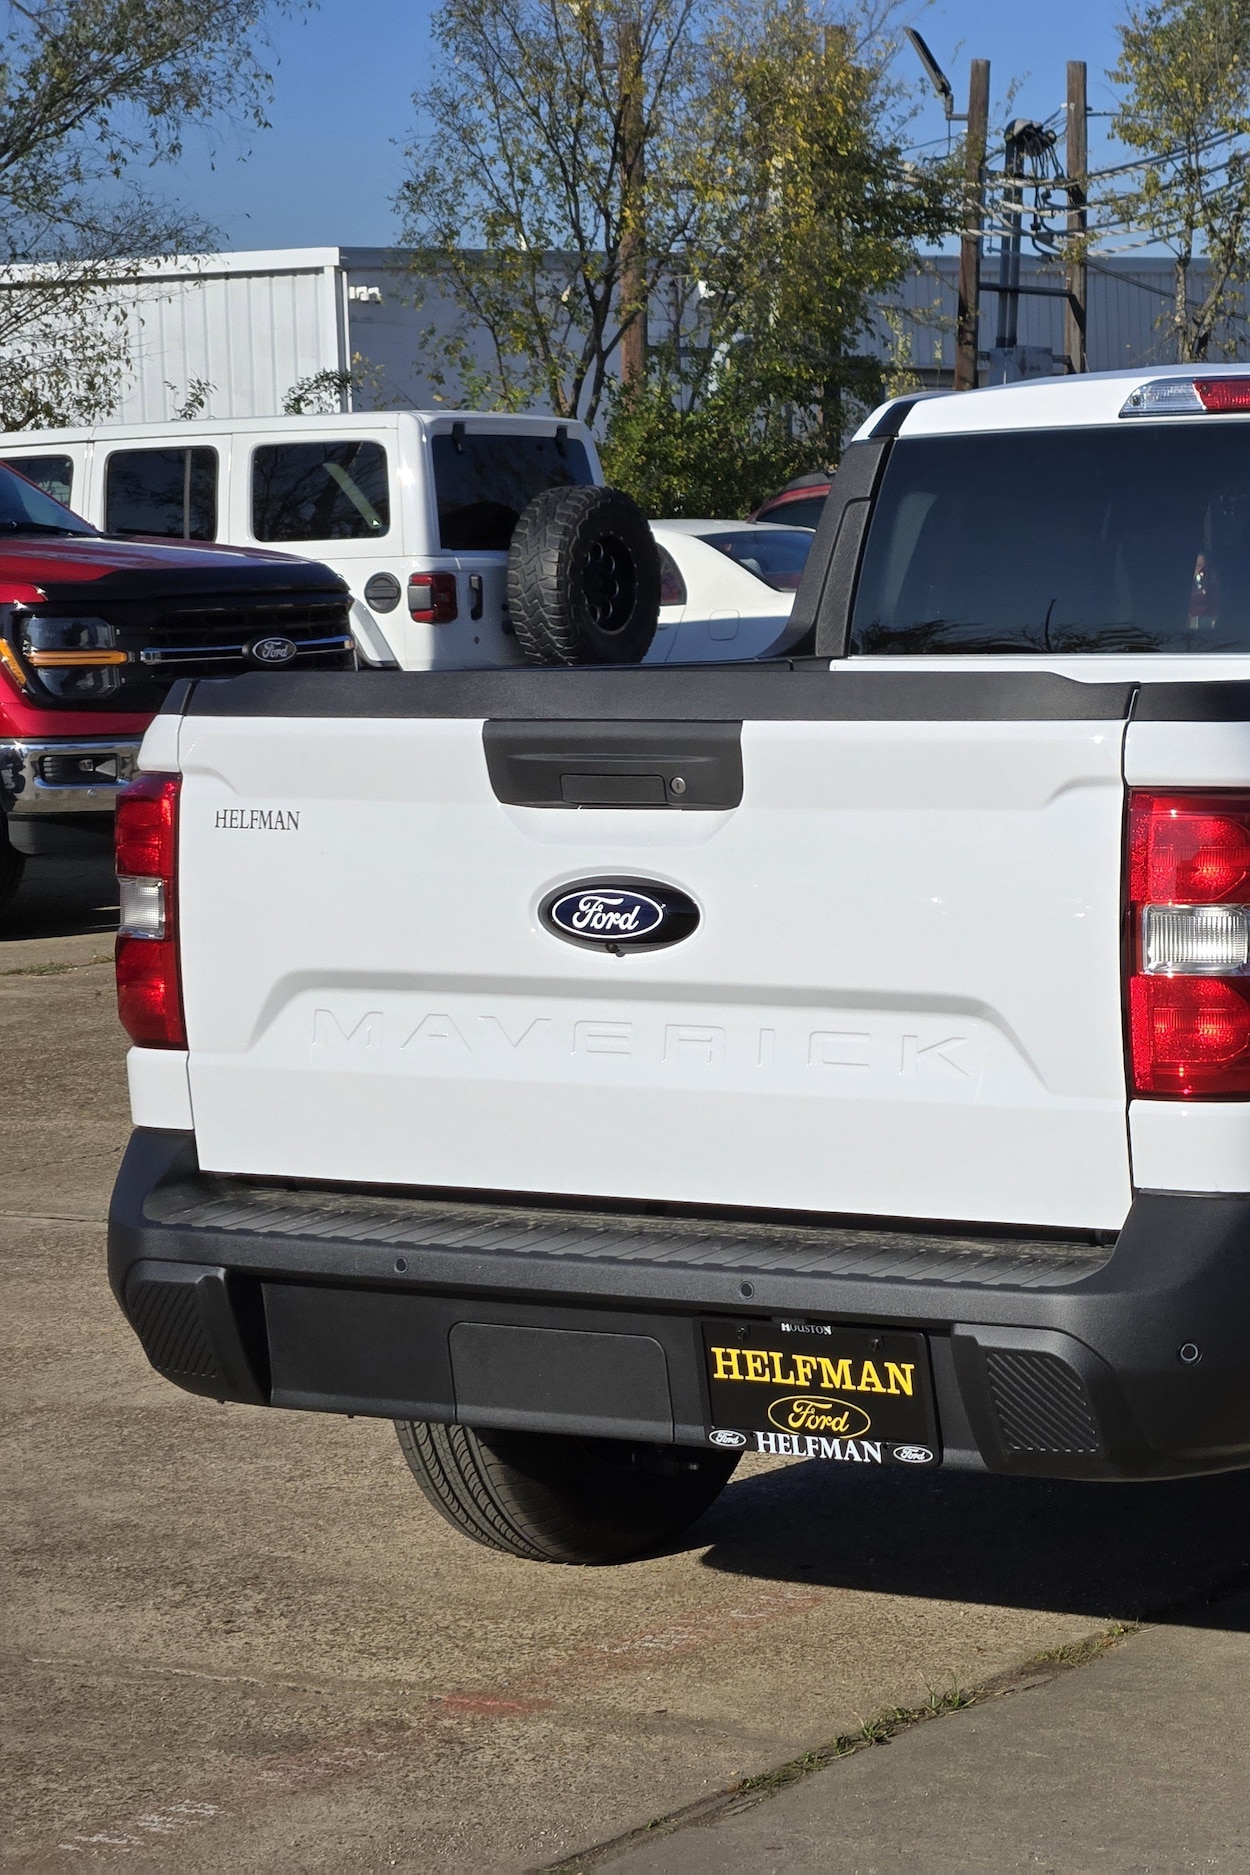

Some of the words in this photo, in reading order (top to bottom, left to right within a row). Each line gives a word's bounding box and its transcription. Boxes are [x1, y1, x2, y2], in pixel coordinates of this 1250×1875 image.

[262, 641, 289, 658] Ford
[214, 809, 300, 830] HELFMAN
[572, 896, 642, 930] Ford
[311, 1008, 970, 1077] MAVERICK
[781, 1322, 832, 1336] HOUSTON
[711, 1347, 915, 1396] HELFMAN
[788, 1399, 850, 1433] Ford
[715, 1432, 740, 1445] Ford
[755, 1430, 882, 1464] HELFMAN
[900, 1446, 926, 1460] Ford
